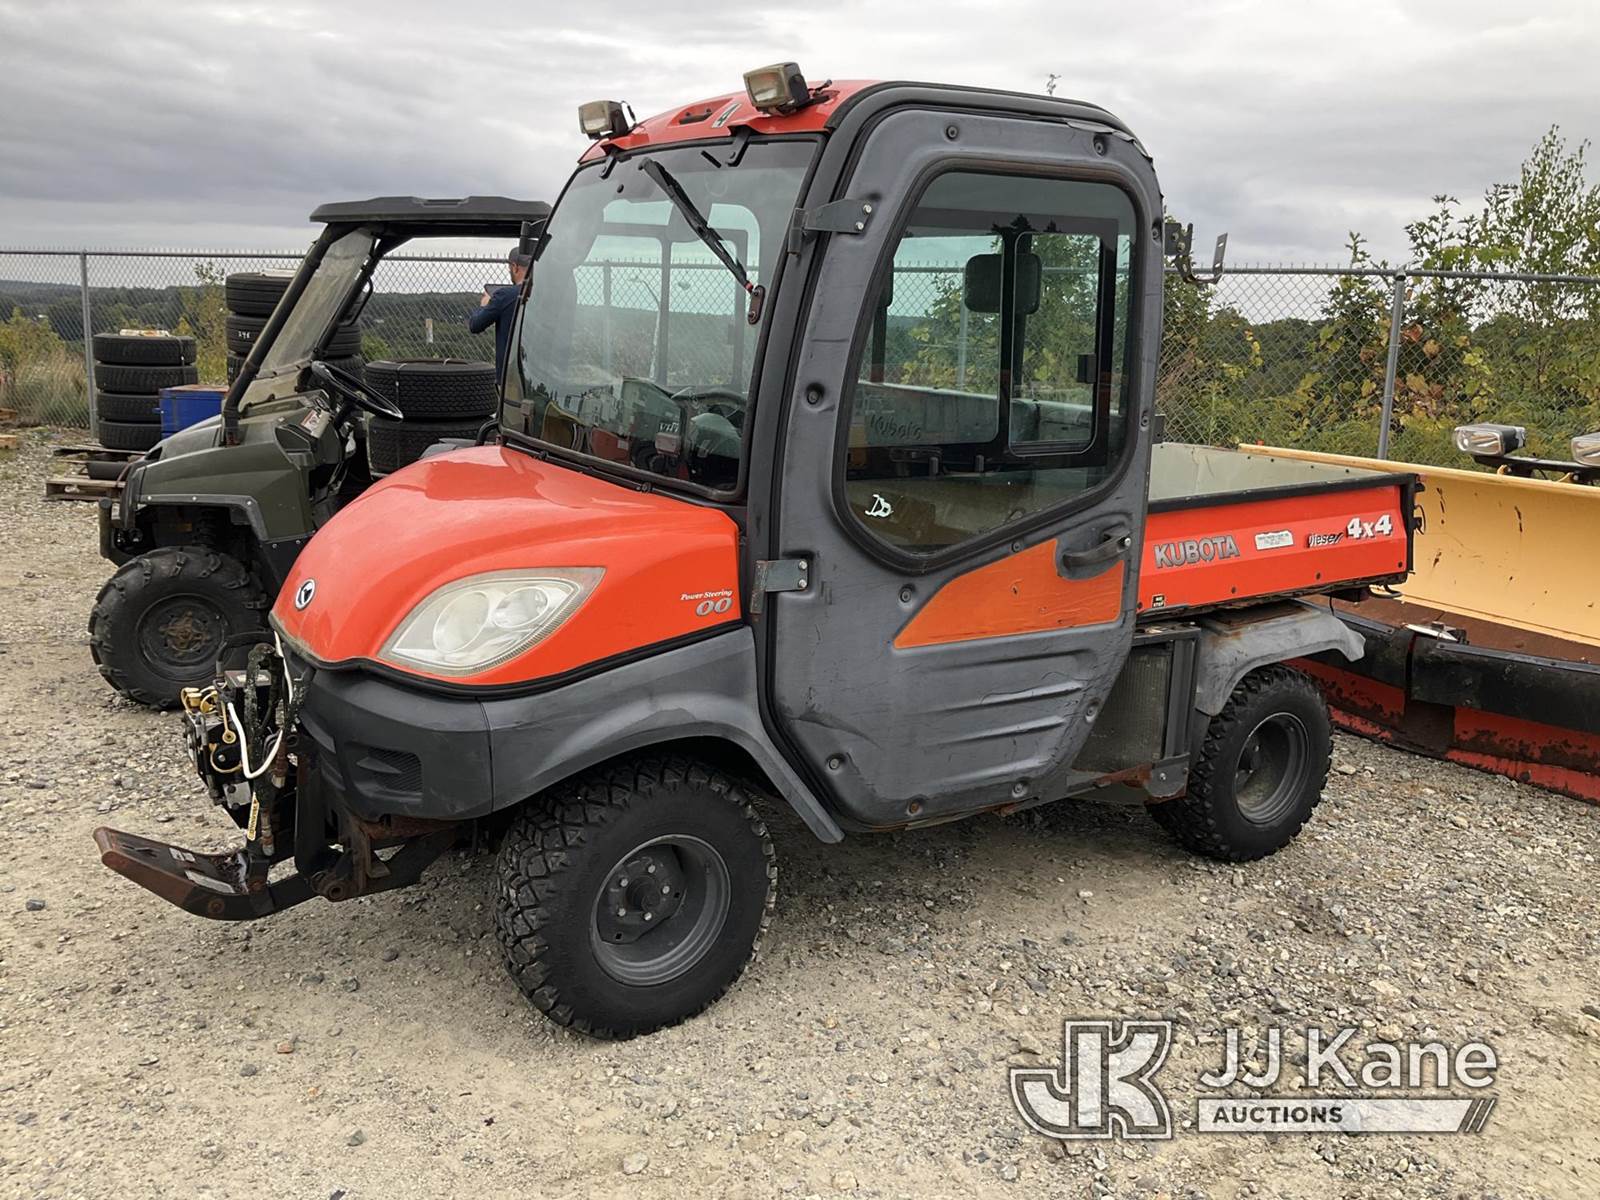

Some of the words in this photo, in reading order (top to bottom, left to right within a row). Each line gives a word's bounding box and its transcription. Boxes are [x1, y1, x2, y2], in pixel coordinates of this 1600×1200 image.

[1346, 514, 1393, 539] 4x4
[1153, 535, 1240, 568] KUBOTA
[680, 592, 704, 601] Power
[703, 589, 733, 599] Steering
